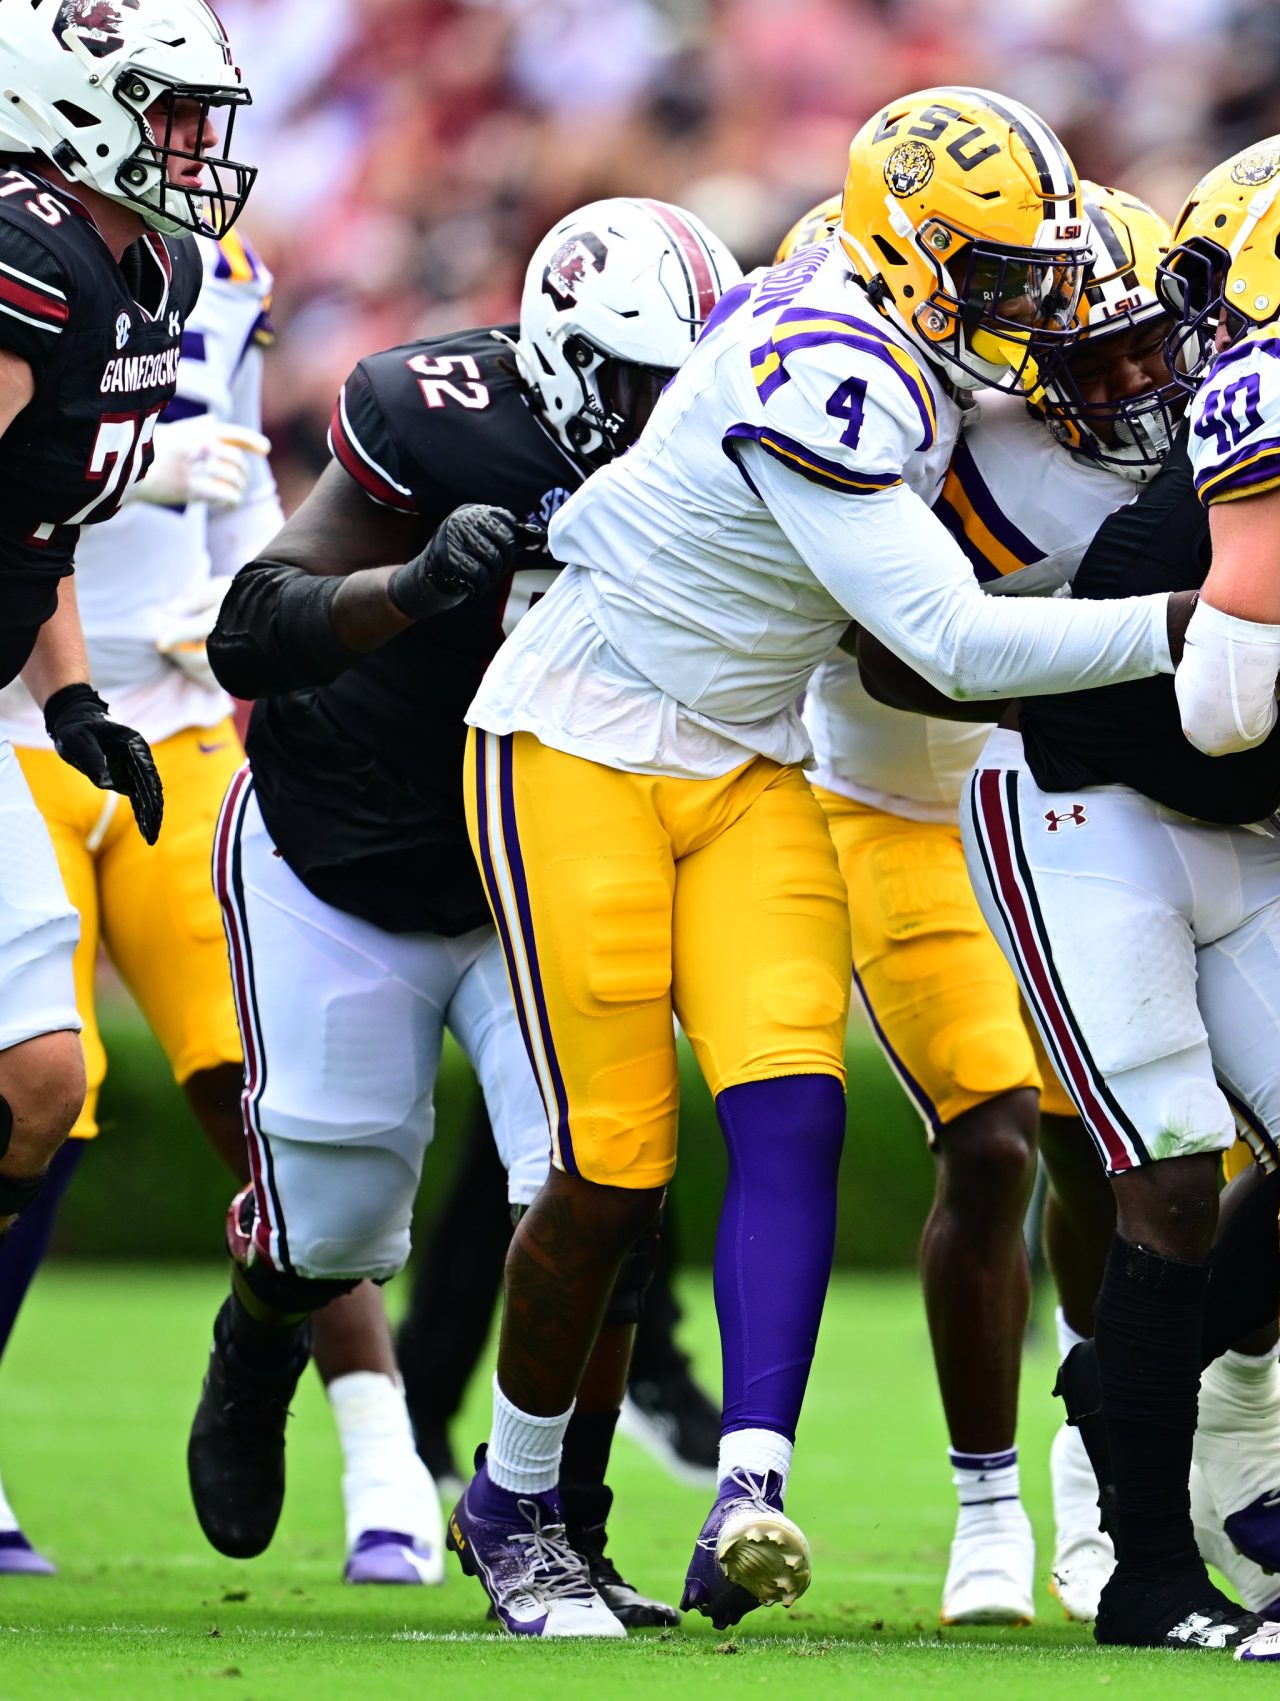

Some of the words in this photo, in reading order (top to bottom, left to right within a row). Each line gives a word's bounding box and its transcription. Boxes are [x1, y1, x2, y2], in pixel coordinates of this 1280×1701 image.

[872, 104, 1001, 171] LSU
[0, 170, 71, 227] 75
[1055, 225, 1081, 240] LSU
[1102, 294, 1142, 319] LSU
[100, 346, 180, 393] GAMECOCKS
[406, 354, 490, 410] 52
[826, 375, 868, 451] 4
[1194, 372, 1265, 456] 40
